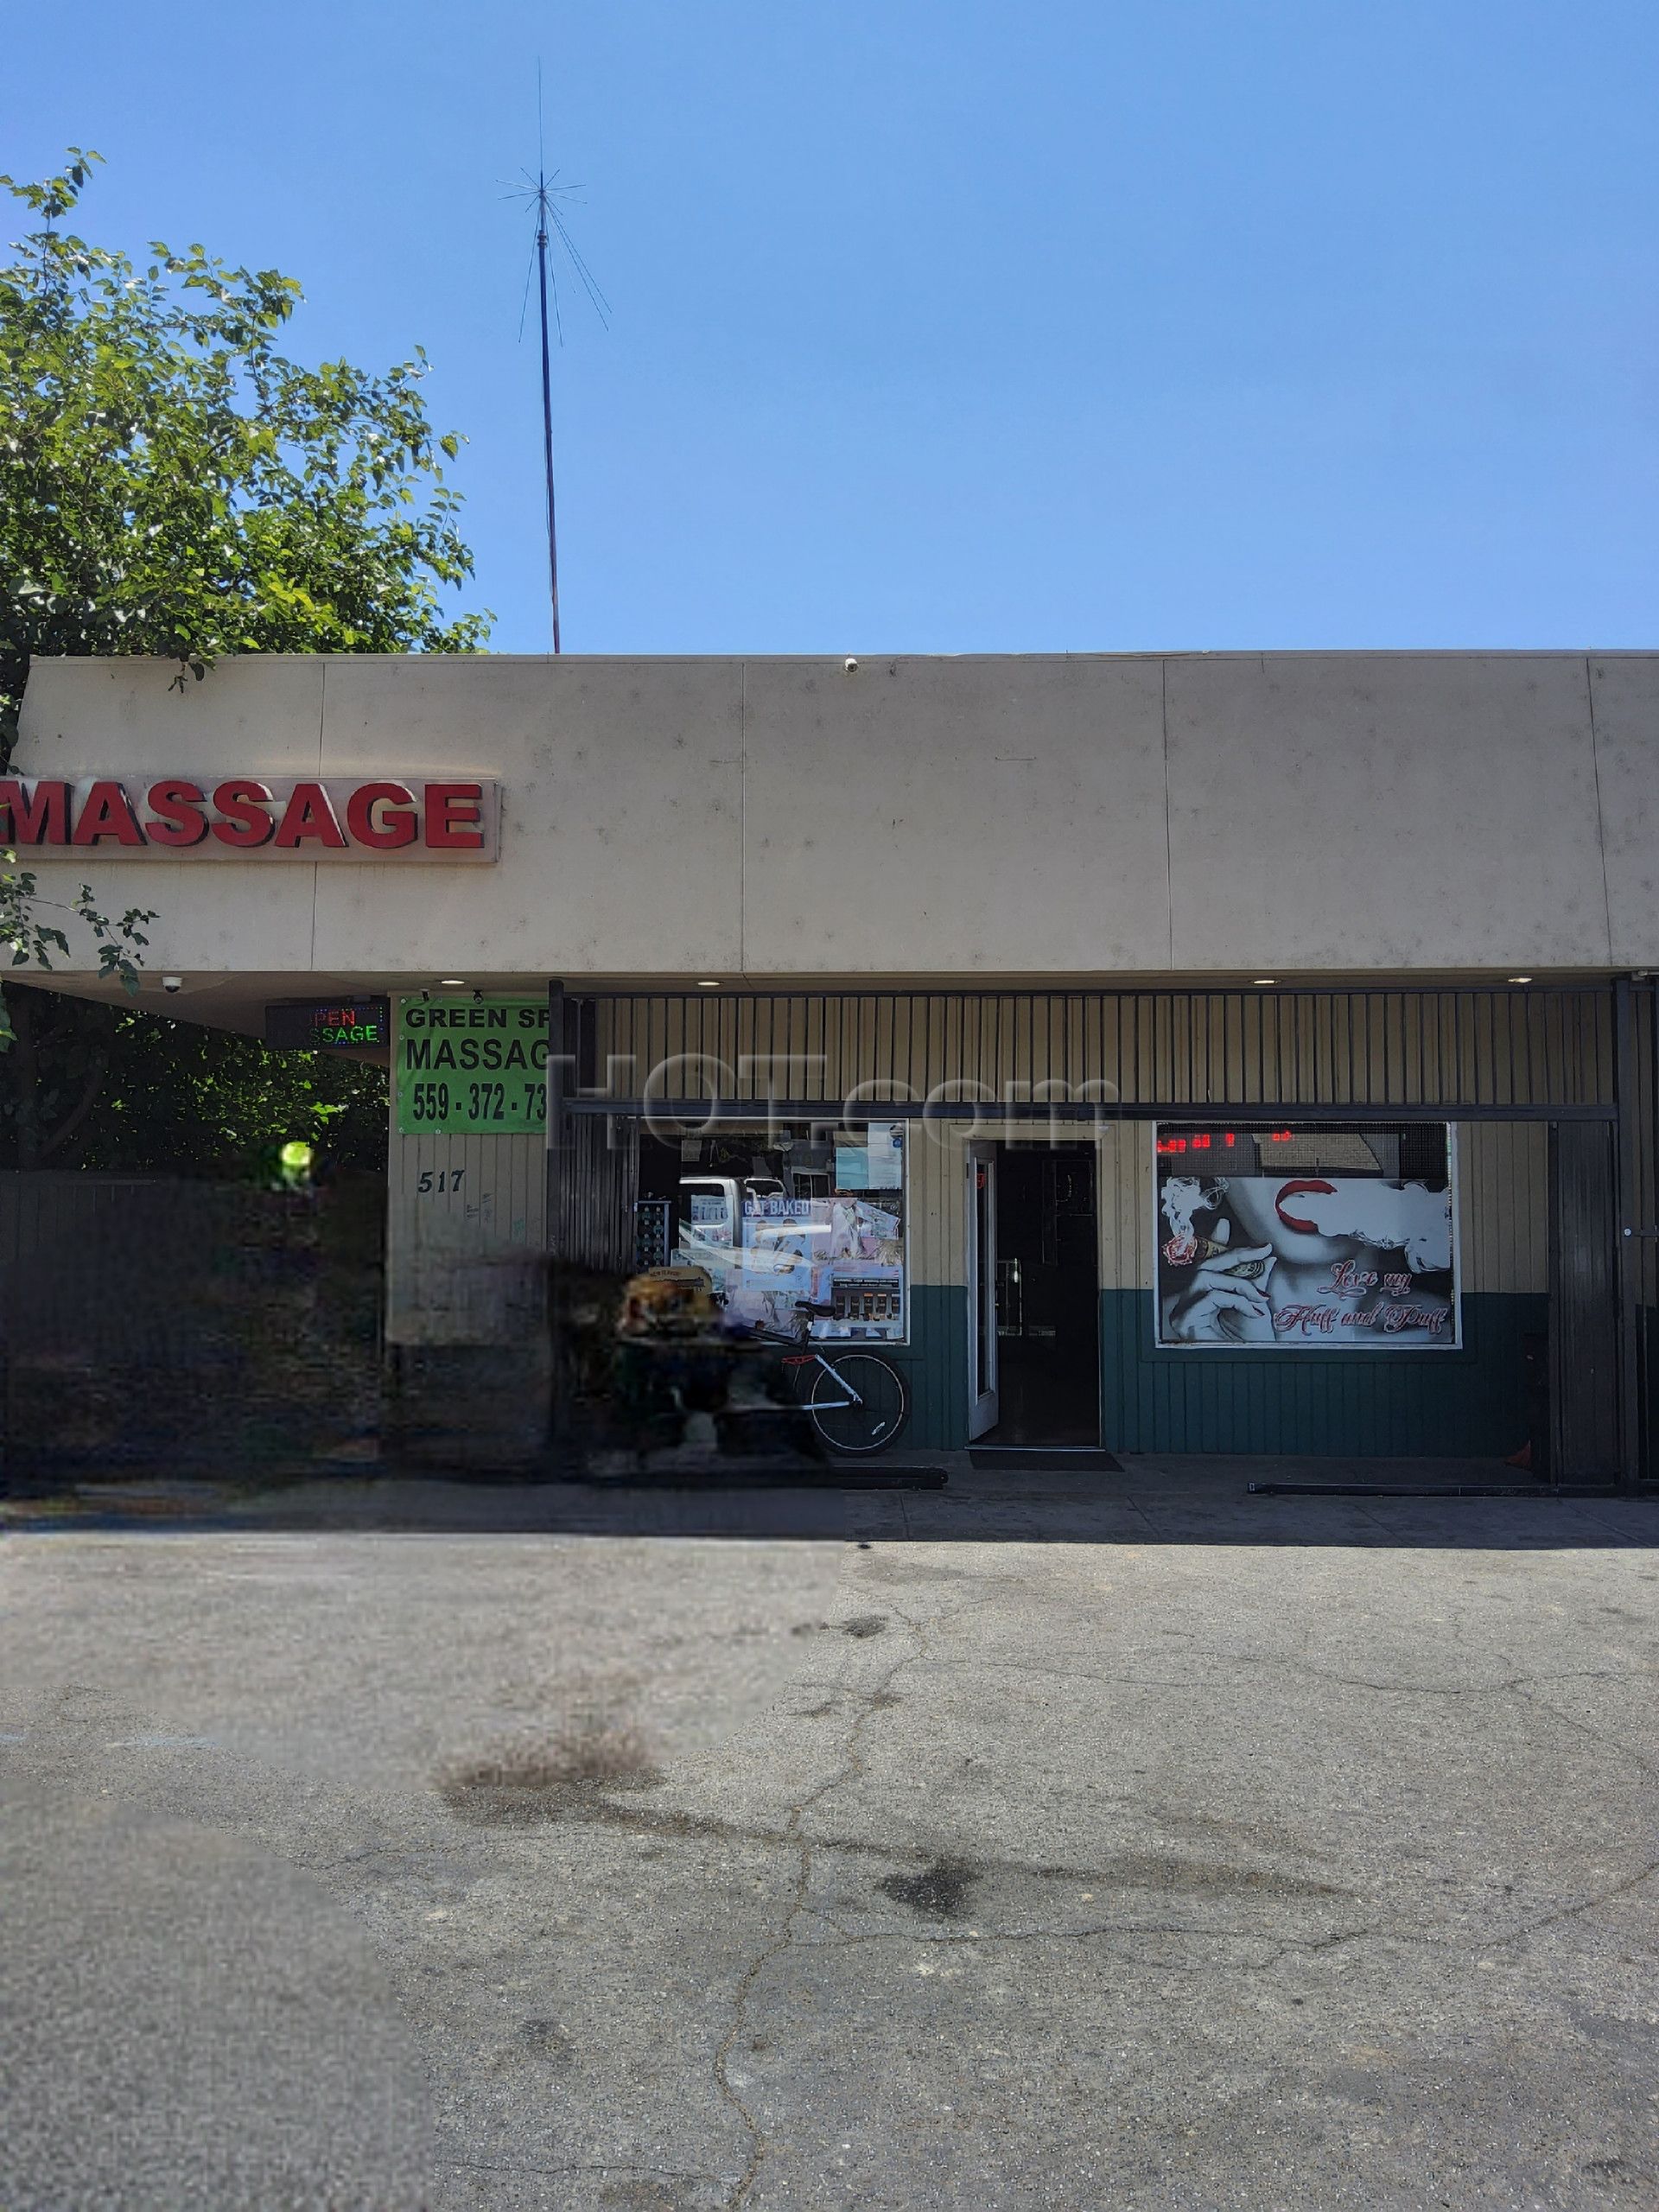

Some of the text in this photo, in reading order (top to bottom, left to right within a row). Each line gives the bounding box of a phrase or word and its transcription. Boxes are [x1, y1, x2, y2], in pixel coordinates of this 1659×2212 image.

[0, 780, 484, 849] MASSAGE
[307, 1009, 355, 1028] PEN
[405, 1008, 507, 1028] GREEN
[417, 1170, 465, 1193] 517
[769, 1200, 810, 1216] BAKED
[1317, 1259, 1413, 1300] Love my
[1274, 1301, 1447, 1336] Huff and Puff
